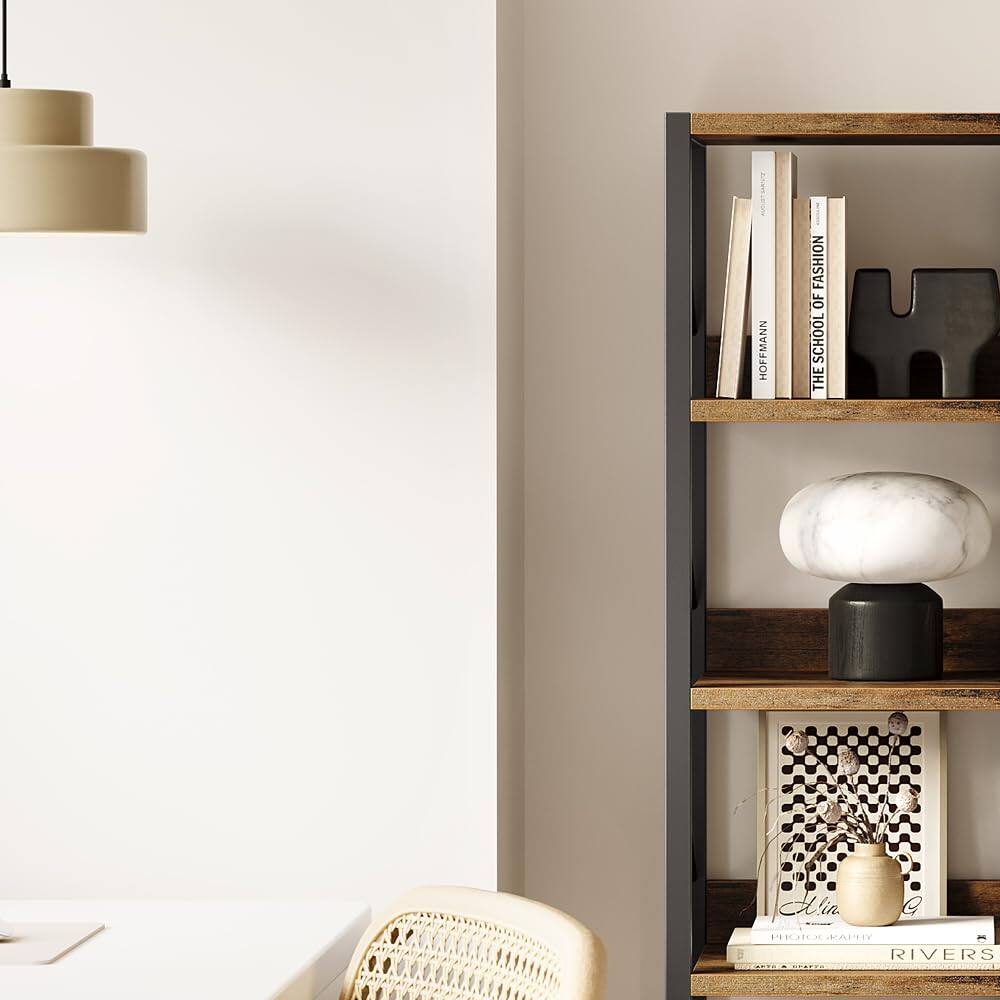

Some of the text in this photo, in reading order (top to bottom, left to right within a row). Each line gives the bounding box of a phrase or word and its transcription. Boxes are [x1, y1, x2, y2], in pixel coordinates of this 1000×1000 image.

[812, 235, 825, 392] THE SCHOOL OF FASHION
[759, 319, 768, 381] HOFFMANN
[771, 933, 873, 942] PHOTOGRAPHY
[891, 947, 995, 961] RIVERS
